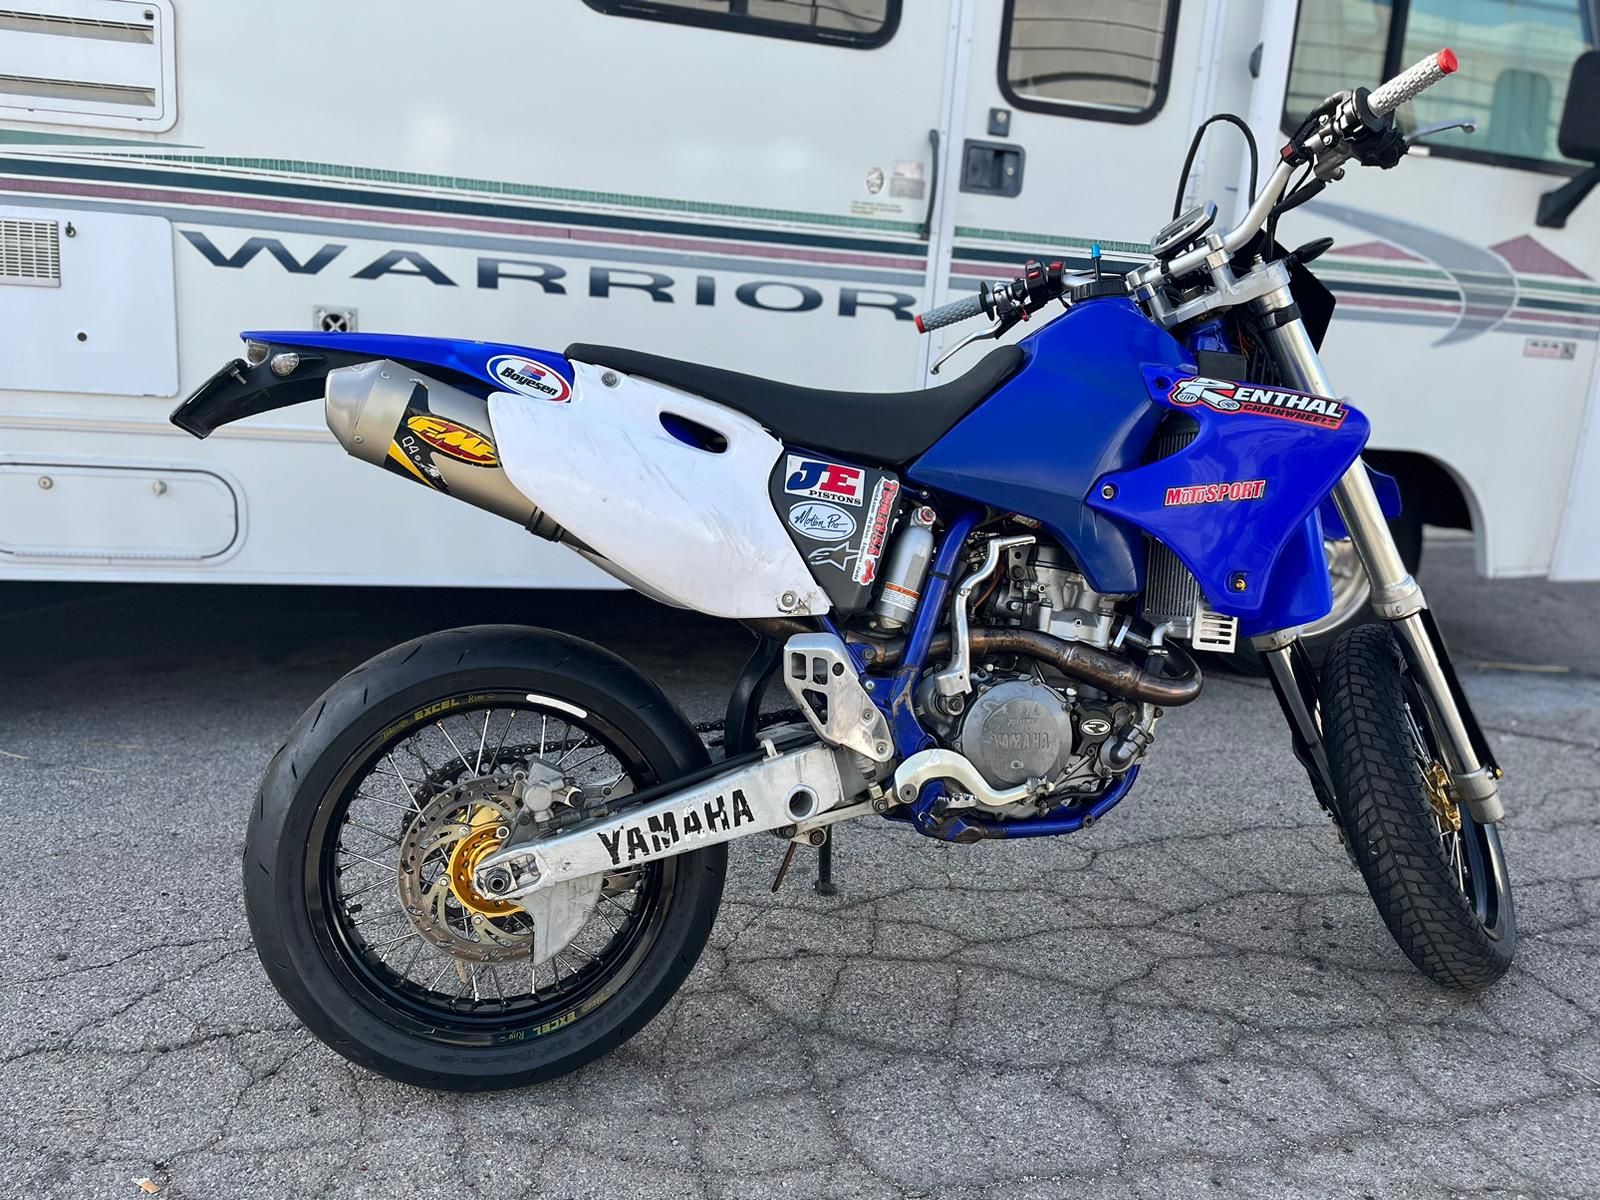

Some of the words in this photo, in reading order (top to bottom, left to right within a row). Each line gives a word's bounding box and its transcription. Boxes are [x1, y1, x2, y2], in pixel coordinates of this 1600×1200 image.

[180, 230, 916, 321] WARRIOR
[500, 366, 559, 397] Boyesen
[1172, 376, 1344, 418] RENTHAL
[1243, 403, 1339, 427] CHAINWHEELS
[402, 435, 420, 455] Q4
[407, 415, 496, 458] FMF
[786, 461, 861, 497] JE
[809, 489, 862, 506] PISTONS
[794, 506, 825, 528] Motion
[825, 513, 849, 530] Pro
[414, 698, 459, 721] EXCEL
[992, 731, 1050, 750] YAMAHA
[597, 788, 755, 866] YAMAHA
[532, 1011, 577, 1036] EXCEL
